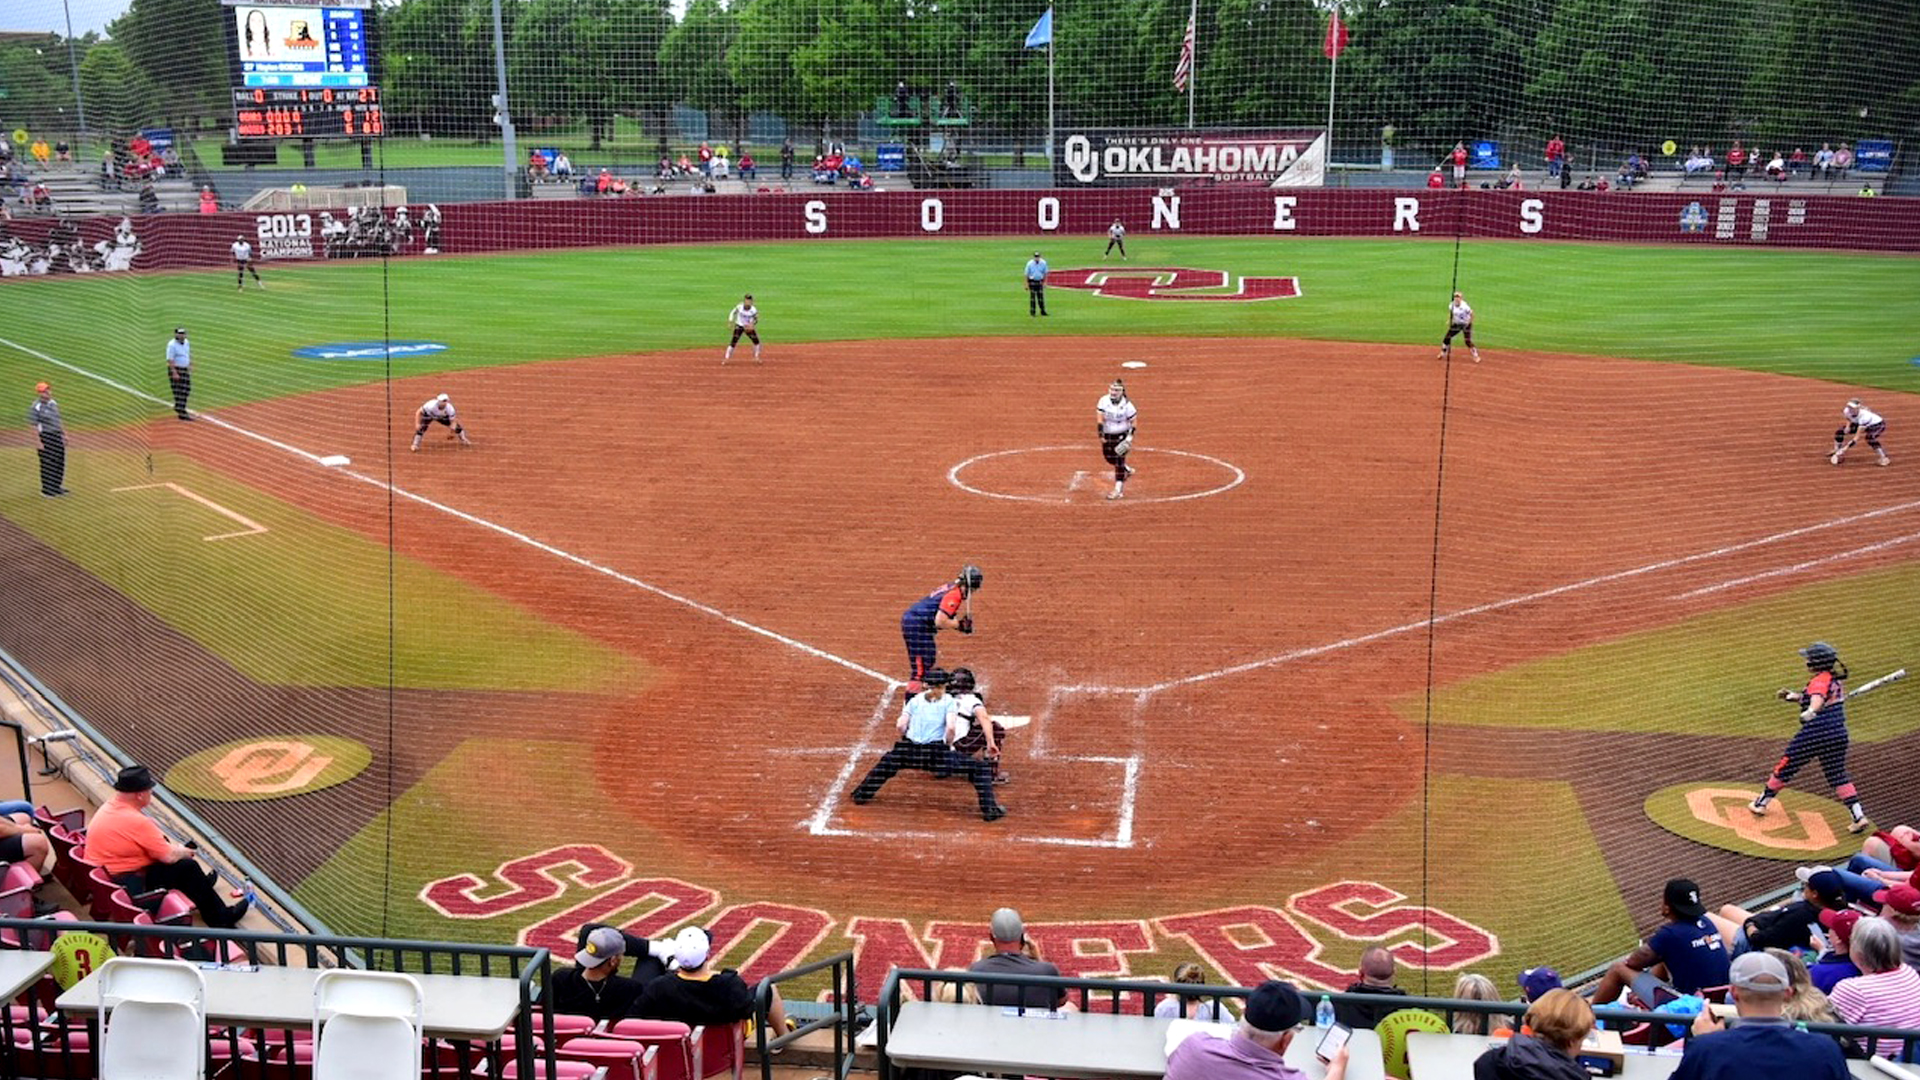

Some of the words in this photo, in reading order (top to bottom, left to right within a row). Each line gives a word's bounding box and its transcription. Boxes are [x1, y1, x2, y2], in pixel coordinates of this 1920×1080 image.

[1064, 135, 1099, 182] OU
[1103, 147, 1299, 173] OKLAHOMA
[1214, 173, 1276, 181] SOFTBALL
[257, 214, 312, 238] 2013
[260, 239, 312, 248] NATIONAL
[260, 247, 313, 257] CHAMPIONS
[75, 949, 92, 981] 3
